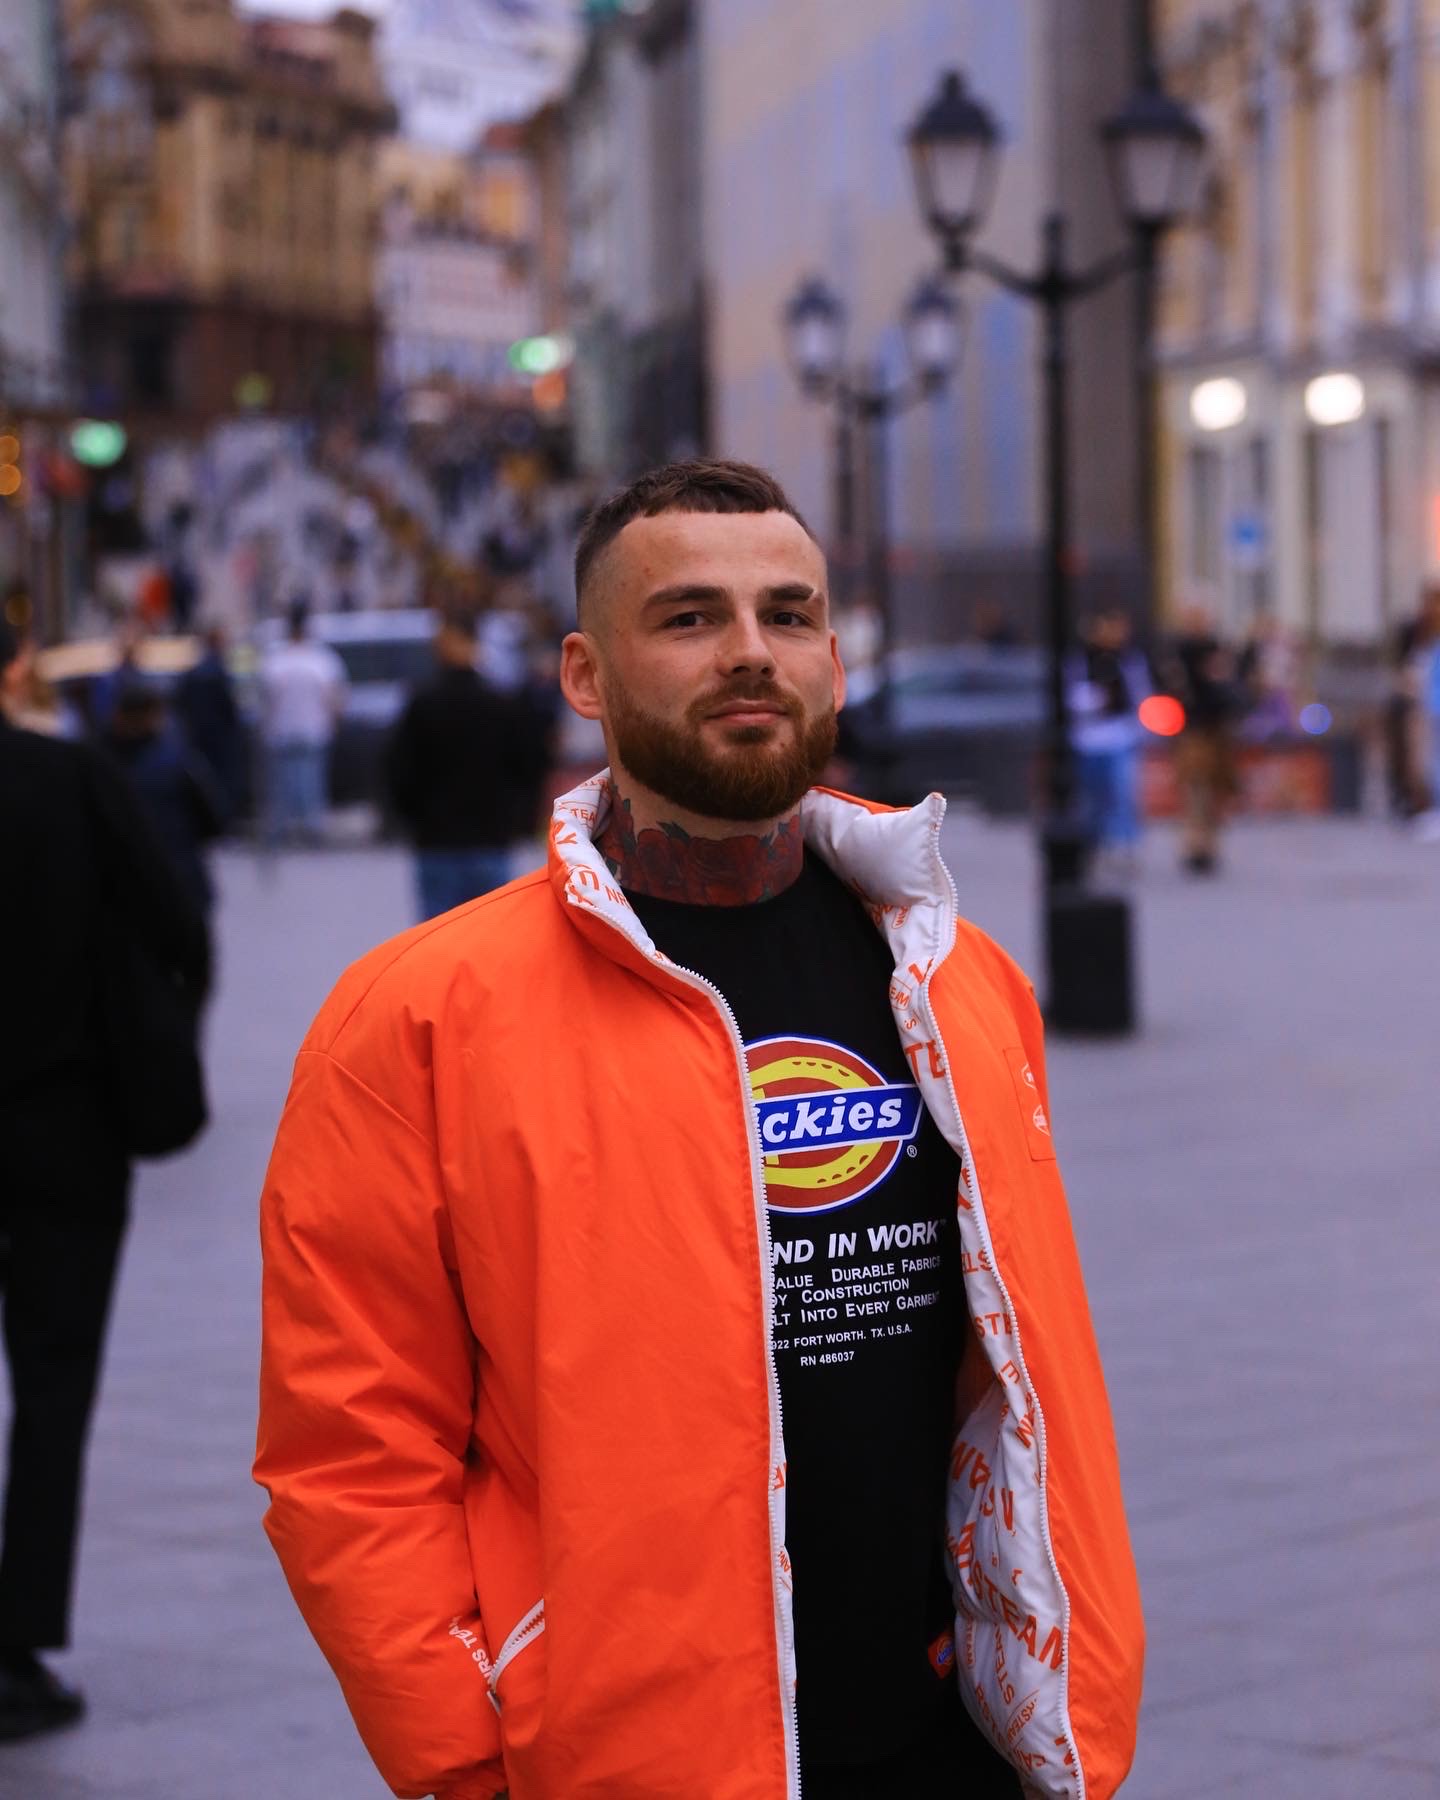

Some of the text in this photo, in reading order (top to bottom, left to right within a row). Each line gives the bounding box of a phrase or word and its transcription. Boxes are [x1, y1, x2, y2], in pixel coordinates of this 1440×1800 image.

[828, 1232, 857, 1259] IN
[867, 1220, 939, 1252] WORK
[772, 1274, 814, 1290] ALUE
[831, 1263, 895, 1283] DURABLE
[801, 1277, 910, 1304] CONSTRUCTION
[801, 1307, 838, 1324] INTO
[845, 1300, 890, 1318] EVERY
[793, 1335, 823, 1348] FORT
[887, 1323, 913, 1336] U.S.A.
[800, 1351, 855, 1367] RN 486037
